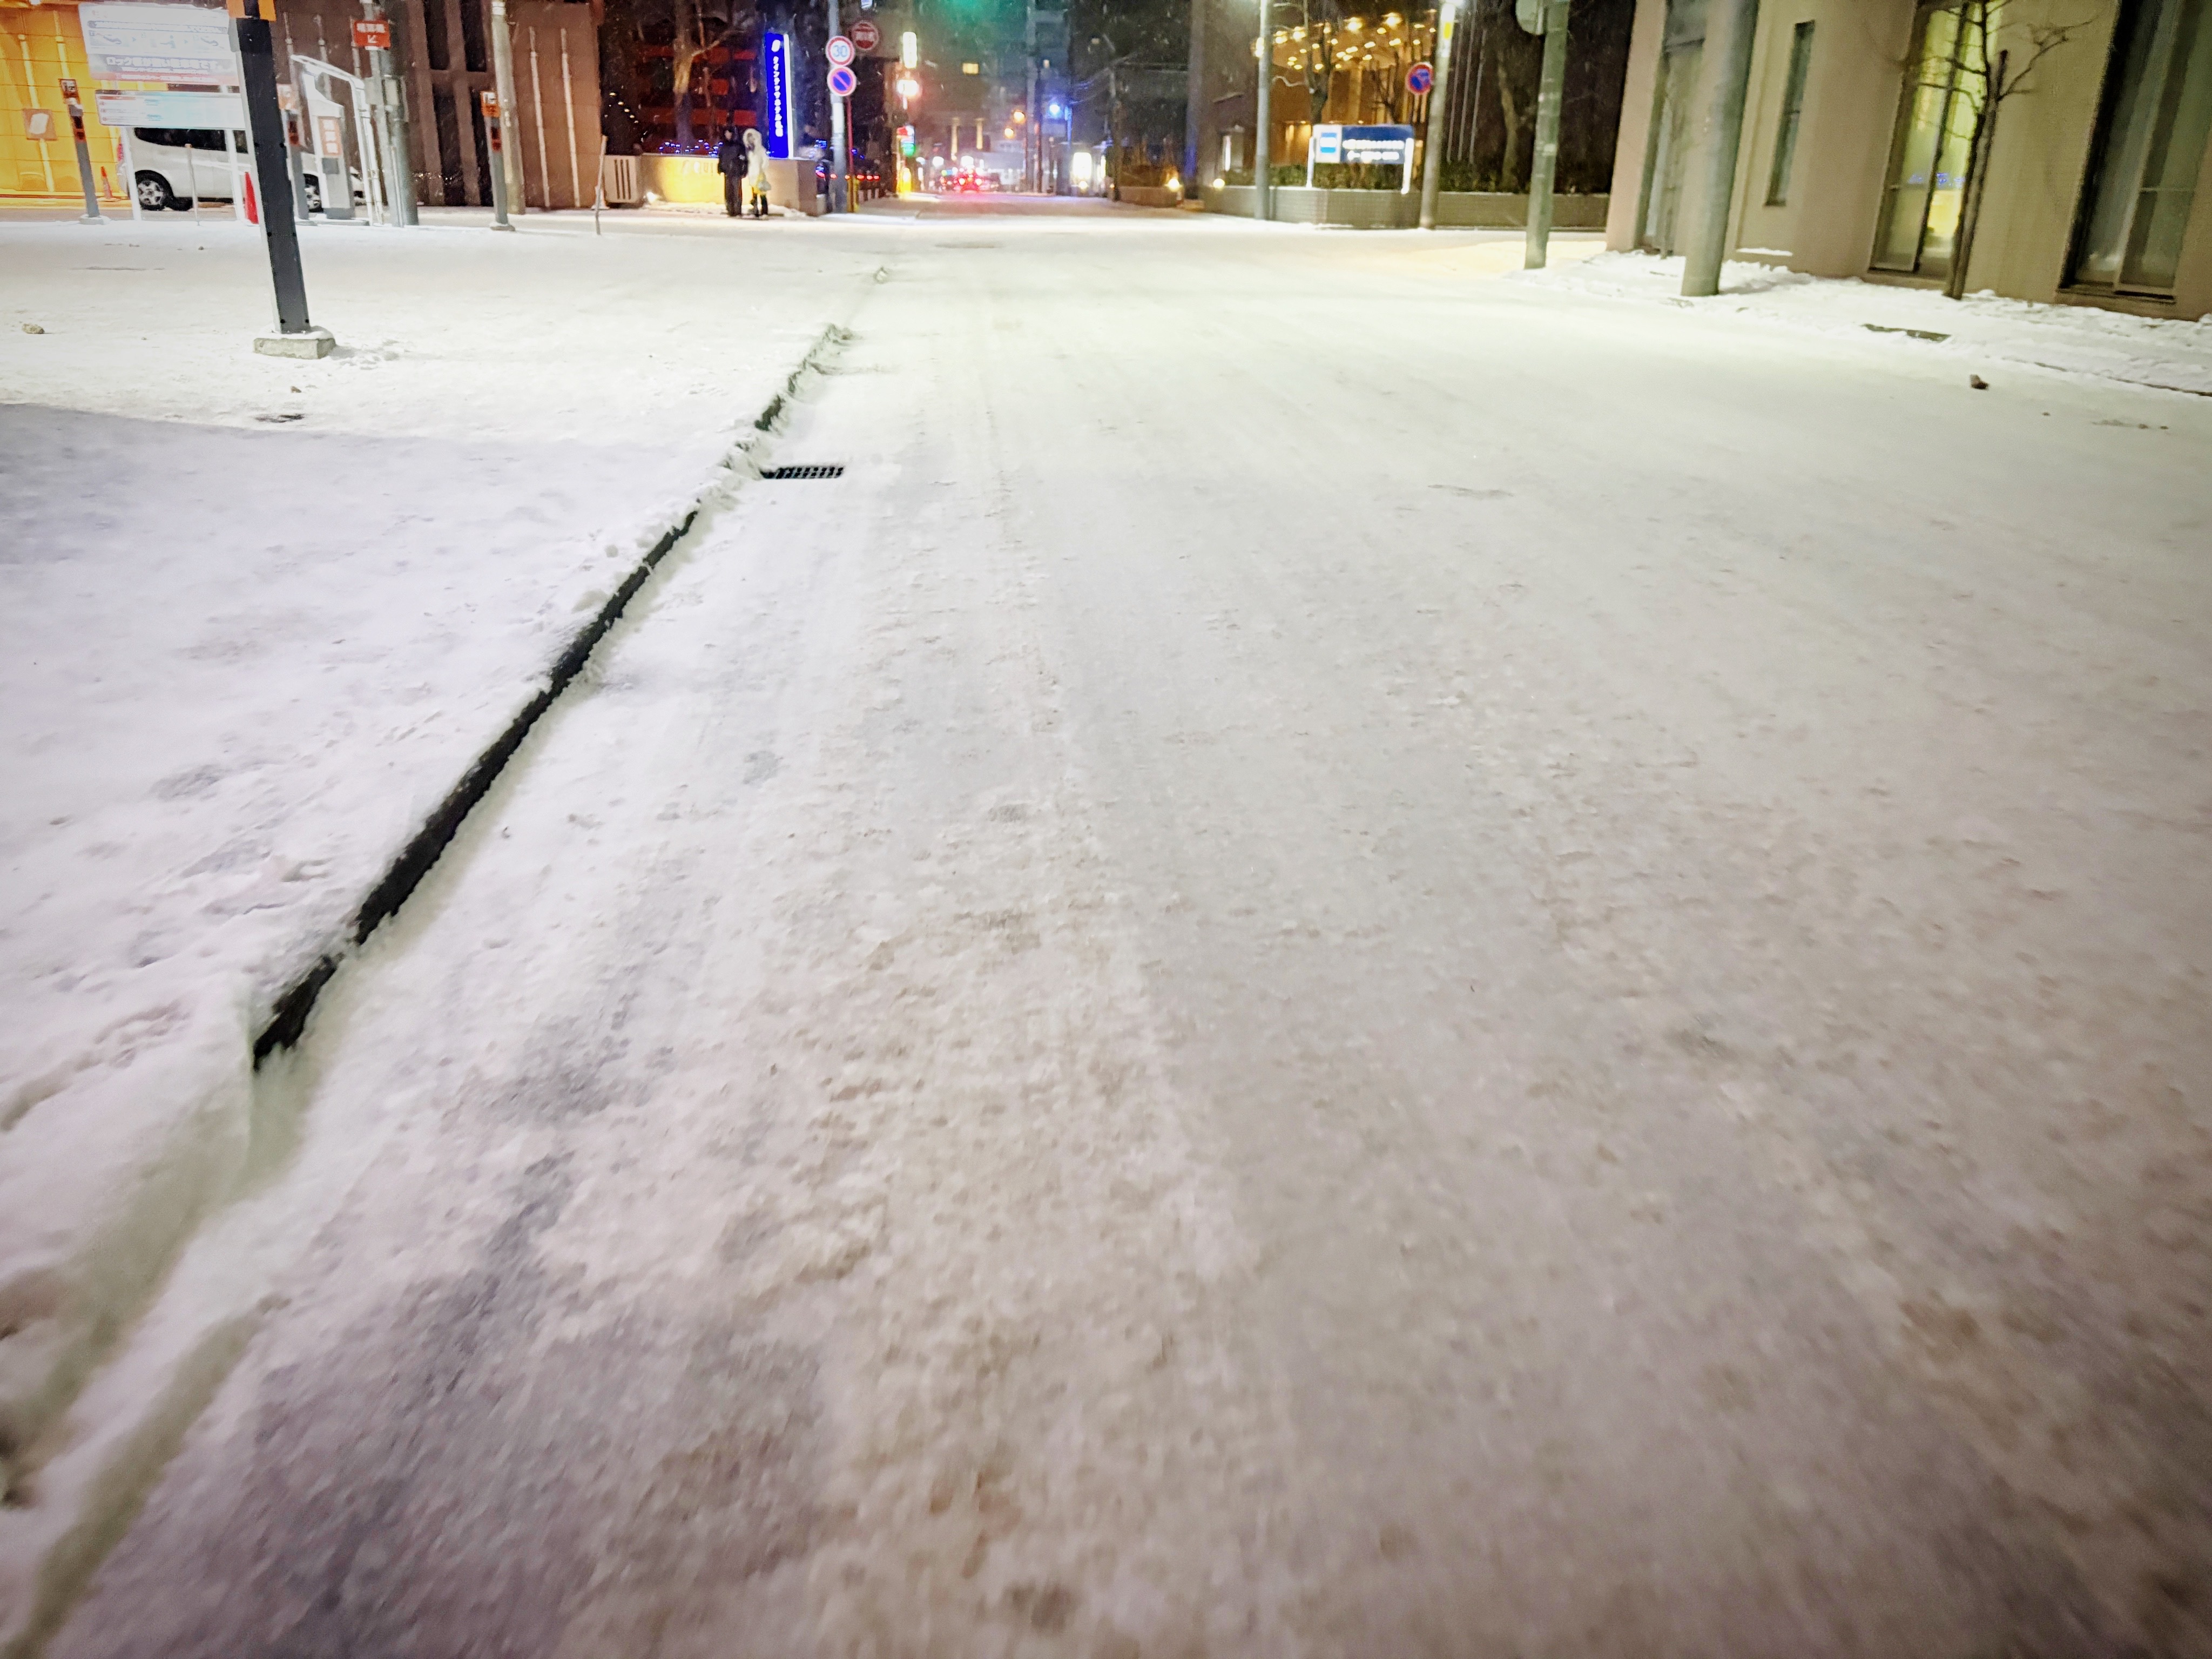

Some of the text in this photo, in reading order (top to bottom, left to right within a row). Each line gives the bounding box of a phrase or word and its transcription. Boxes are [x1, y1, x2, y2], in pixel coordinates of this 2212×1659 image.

[833, 45, 848, 58] 30
[106, 56, 222, 71] ロックがいです。
[773, 56, 784, 137] クインテッサホテル
